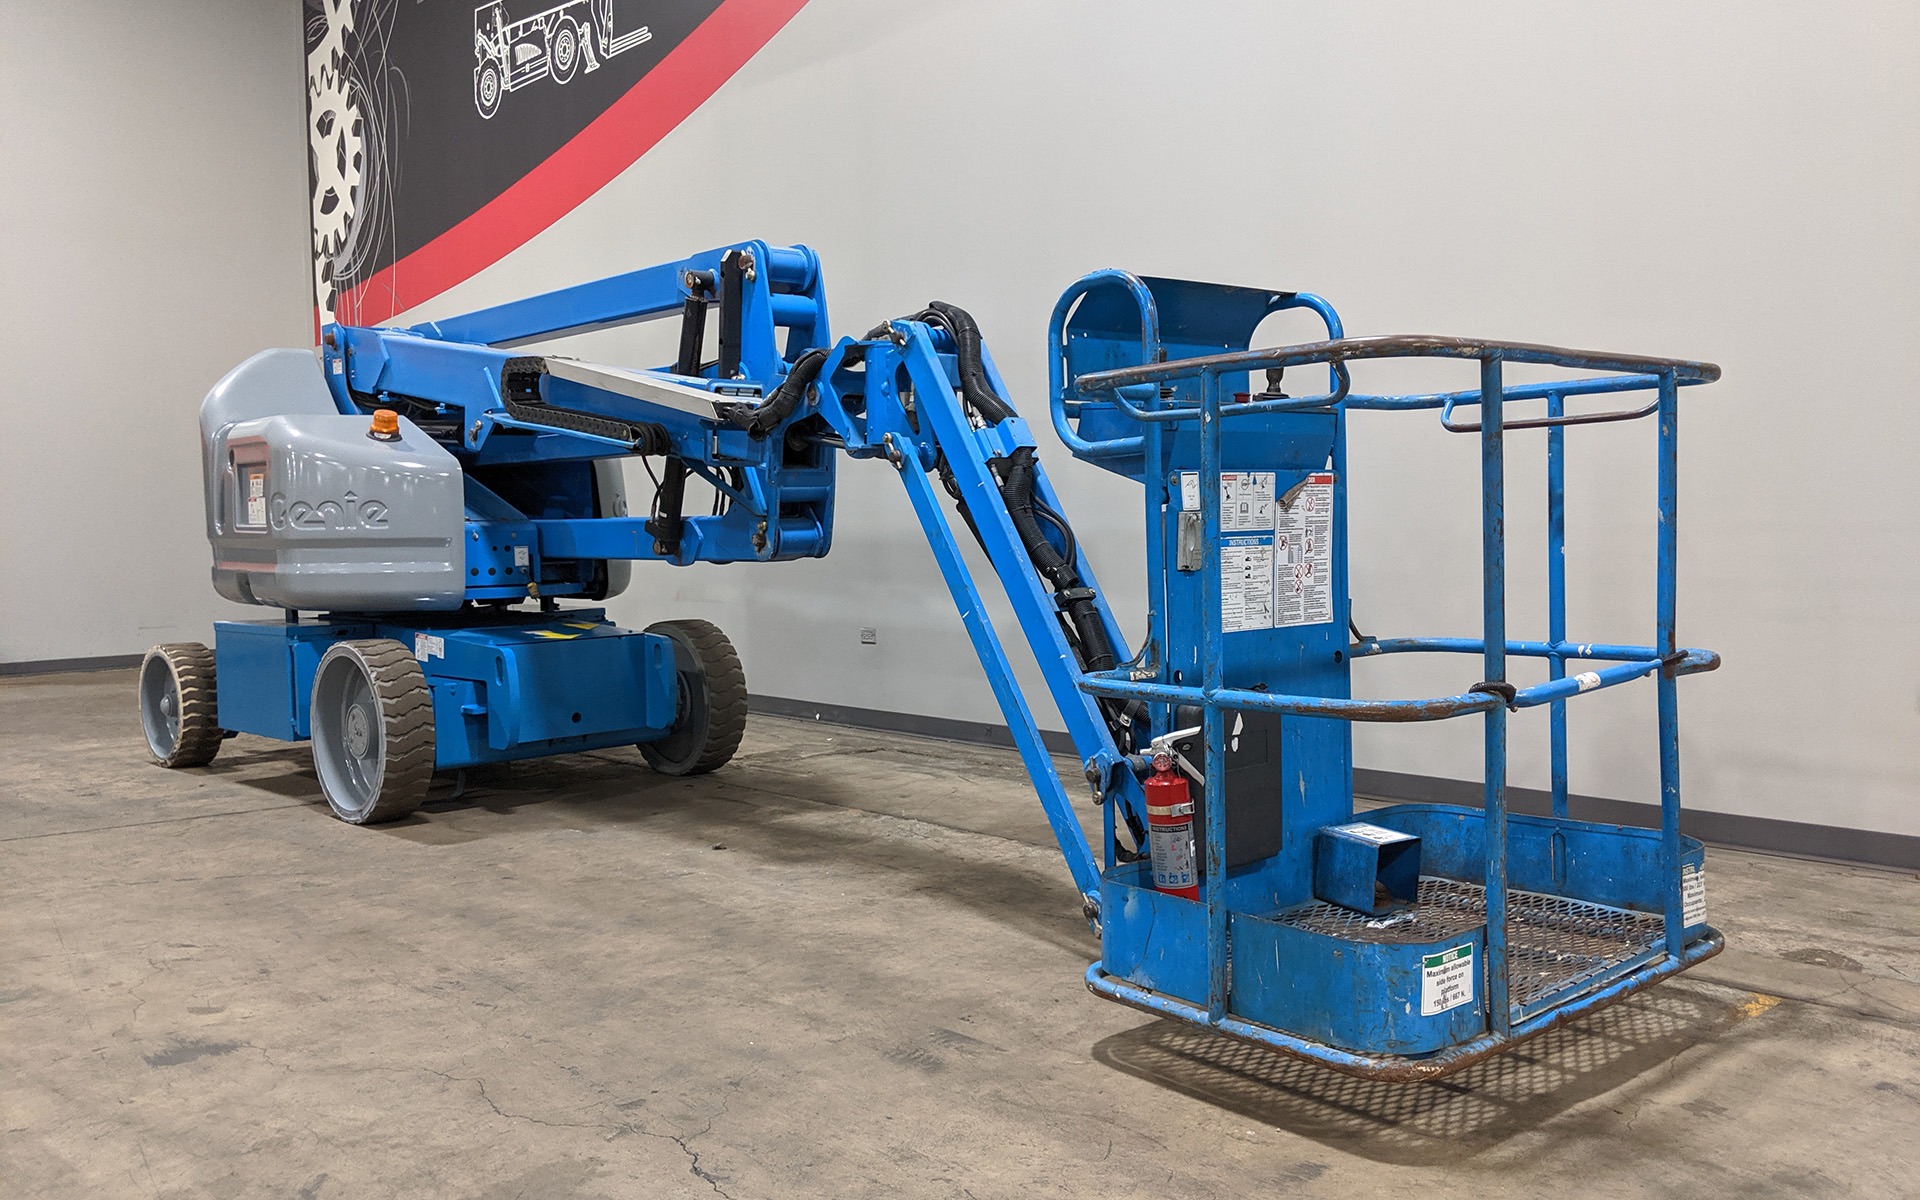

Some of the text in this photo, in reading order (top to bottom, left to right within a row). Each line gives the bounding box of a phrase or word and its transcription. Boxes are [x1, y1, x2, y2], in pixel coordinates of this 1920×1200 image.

[270, 490, 389, 530] Genie
[1229, 538, 1259, 546] INSTRUCTIONS
[1426, 959, 1471, 978] Maximum allowable
[1436, 978, 1446, 987] side
[1446, 974, 1458, 983] force
[1441, 983, 1459, 996] platform
